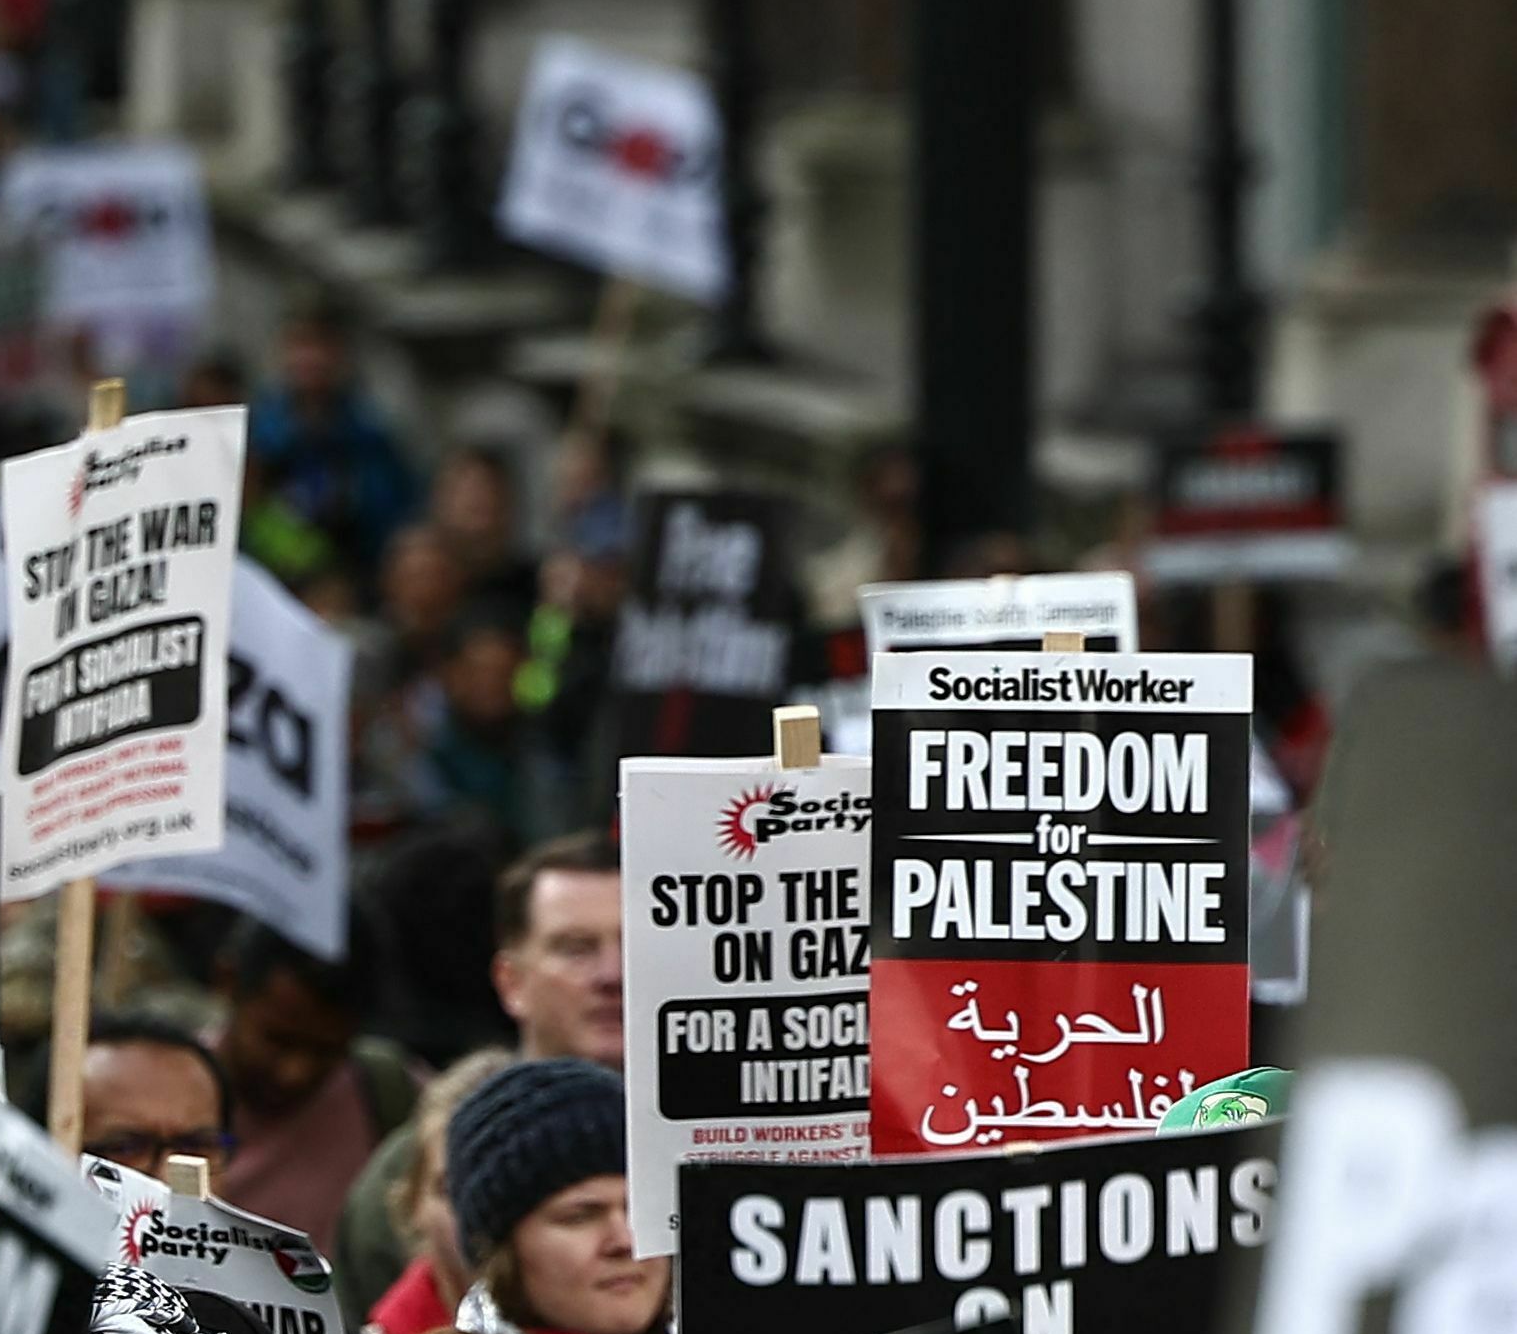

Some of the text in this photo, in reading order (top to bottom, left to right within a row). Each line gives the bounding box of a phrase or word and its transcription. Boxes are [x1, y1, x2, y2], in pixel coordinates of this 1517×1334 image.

[139, 501, 219, 554] WAR
[928, 664, 1194, 703] Socialist Worker
[908, 729, 1210, 814] FREEDOM
[768, 791, 872, 816] Socia
[1035, 813, 1087, 855] for
[651, 867, 860, 927] STOP THE
[890, 859, 1228, 944] PALESTINE
[713, 924, 871, 985] ON GAZ
[665, 1010, 737, 1056] FOR
[746, 1006, 774, 1052] A
[946, 978, 1166, 1064] الحرية
[740, 1054, 871, 1105] INTIFAD
[693, 1126, 747, 1145] BUILD
[729, 1153, 1283, 1288] SANCTIONS
